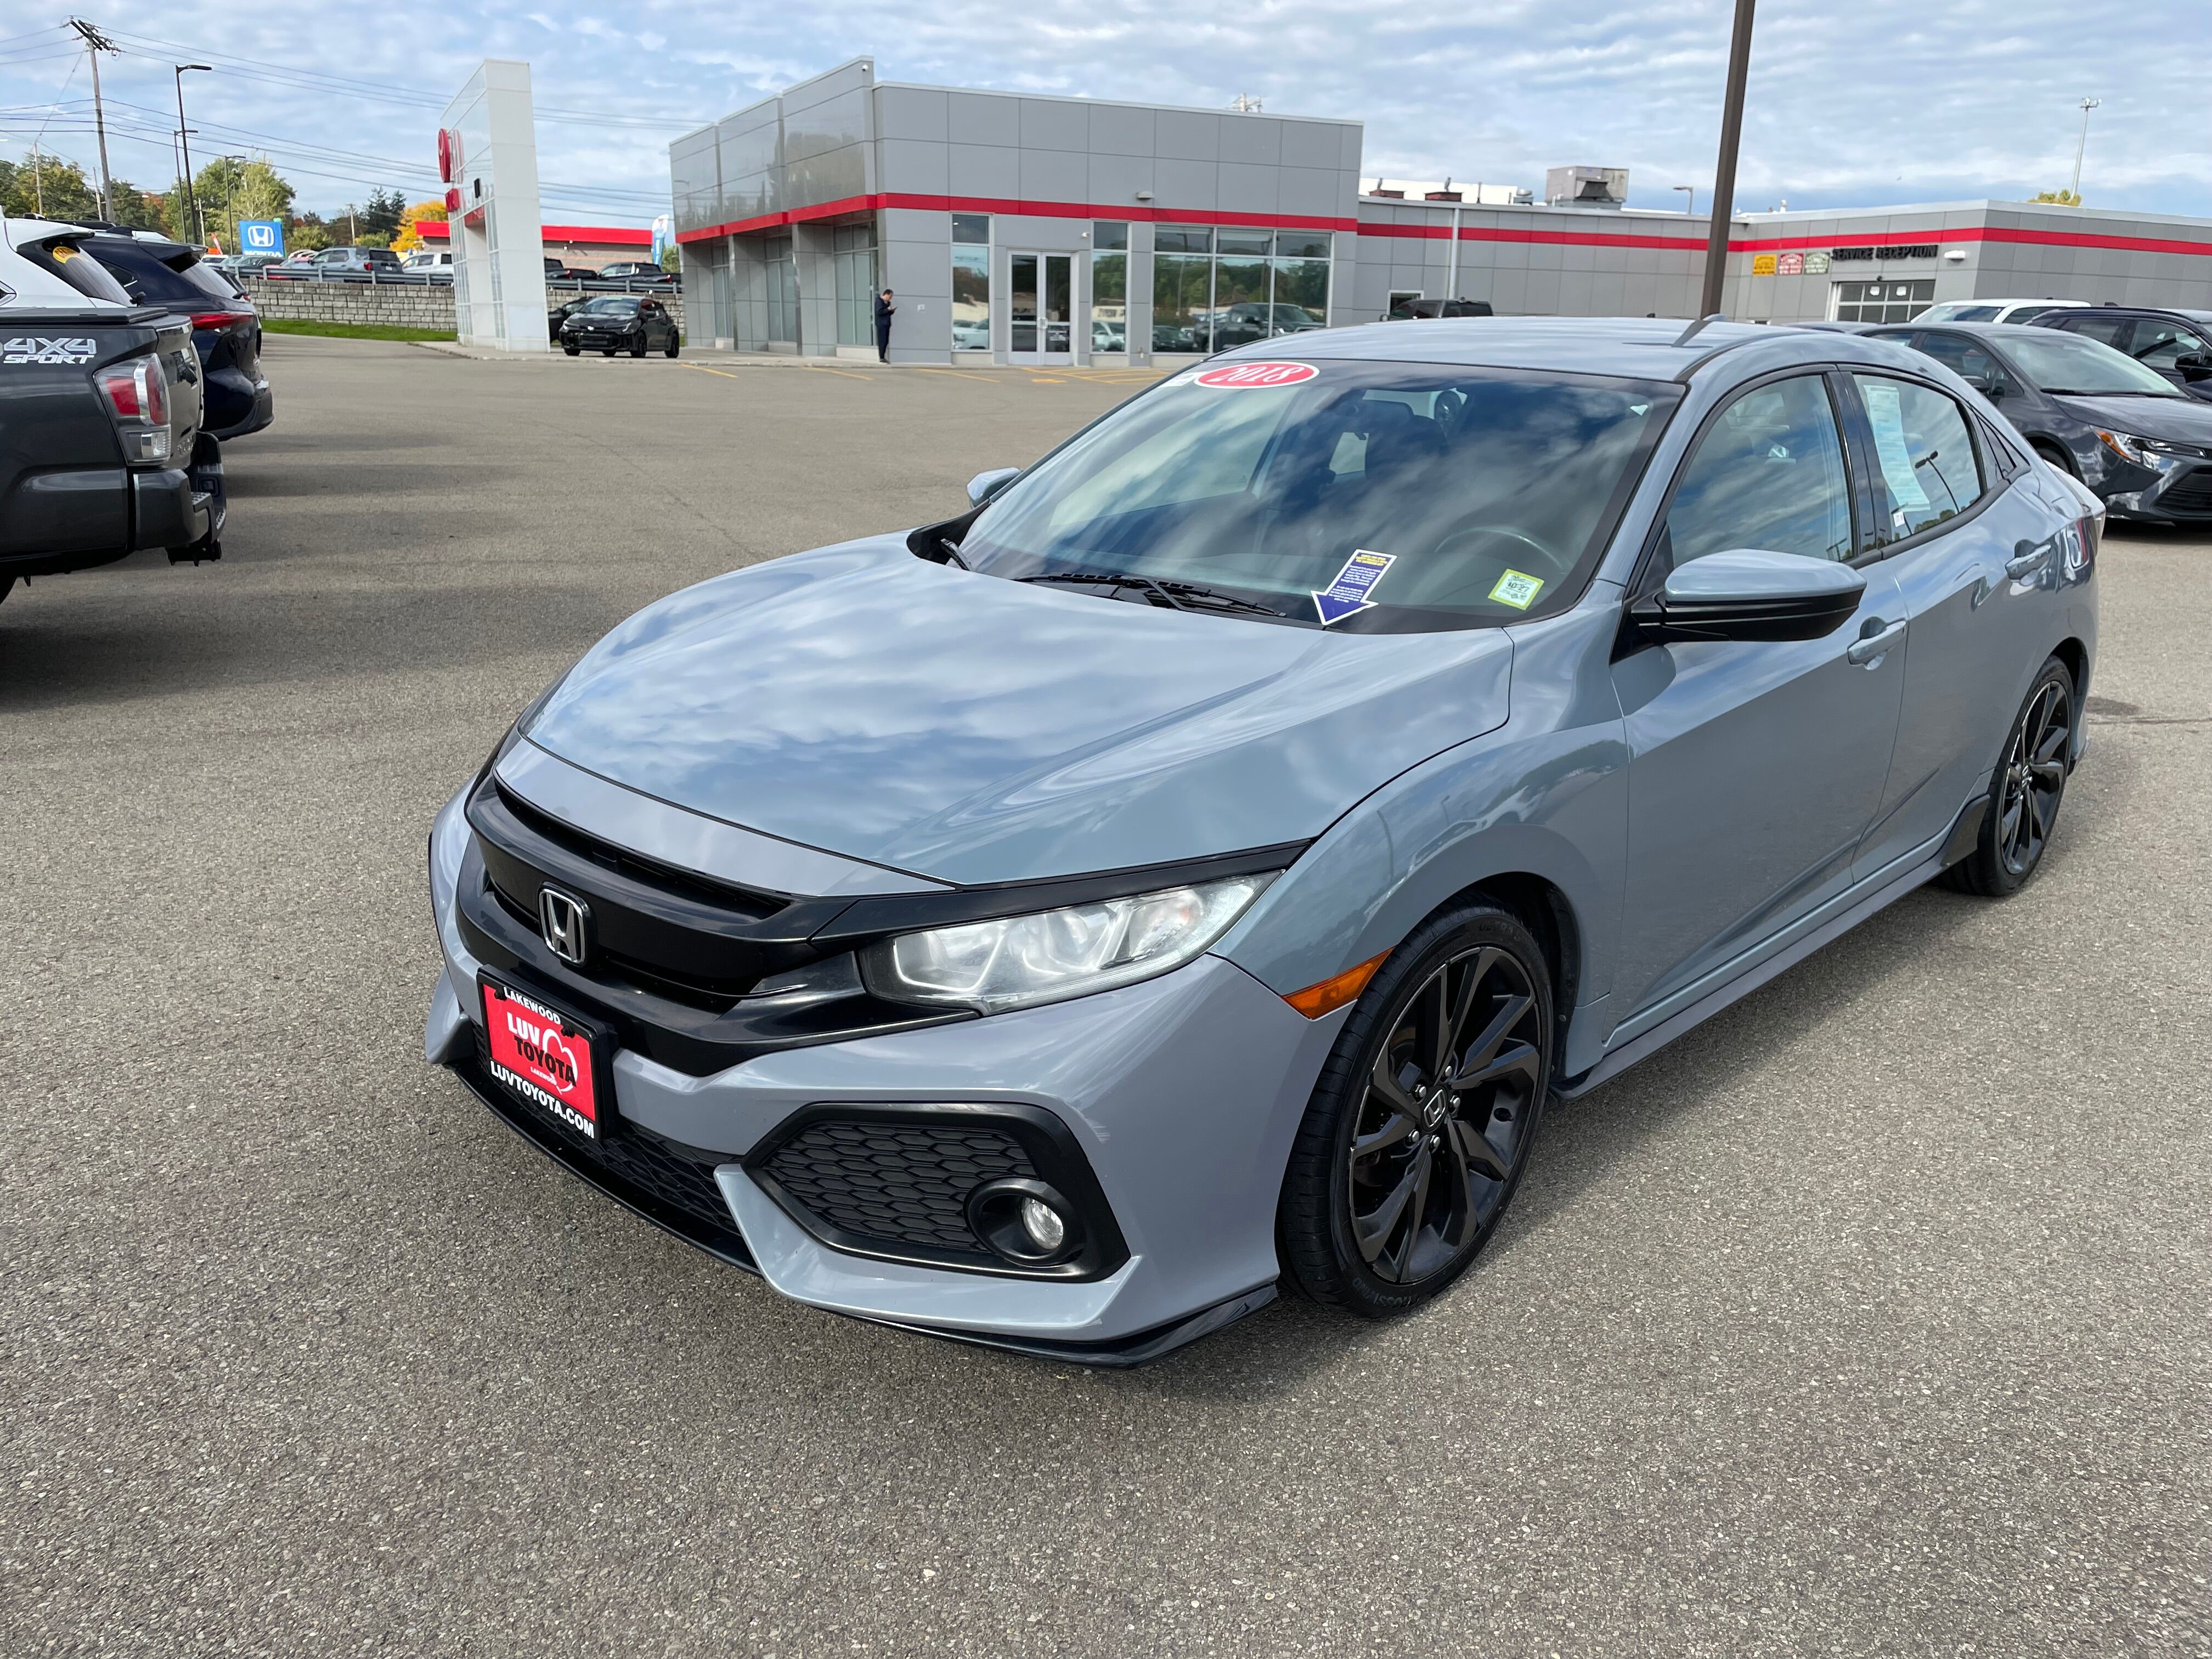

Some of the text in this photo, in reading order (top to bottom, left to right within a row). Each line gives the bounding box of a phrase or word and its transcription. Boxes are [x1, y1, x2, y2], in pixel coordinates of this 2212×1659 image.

[1831, 245, 1939, 261] SERVICE RECEPTION
[3, 354, 95, 364] SPORT
[1207, 366, 1305, 382] 2018
[504, 986, 561, 1025] LAKEWOOD
[506, 1012, 540, 1046] LUV
[514, 1035, 577, 1088] TOYOTA
[490, 1060, 595, 1139] LUVTOYOTA.COM
